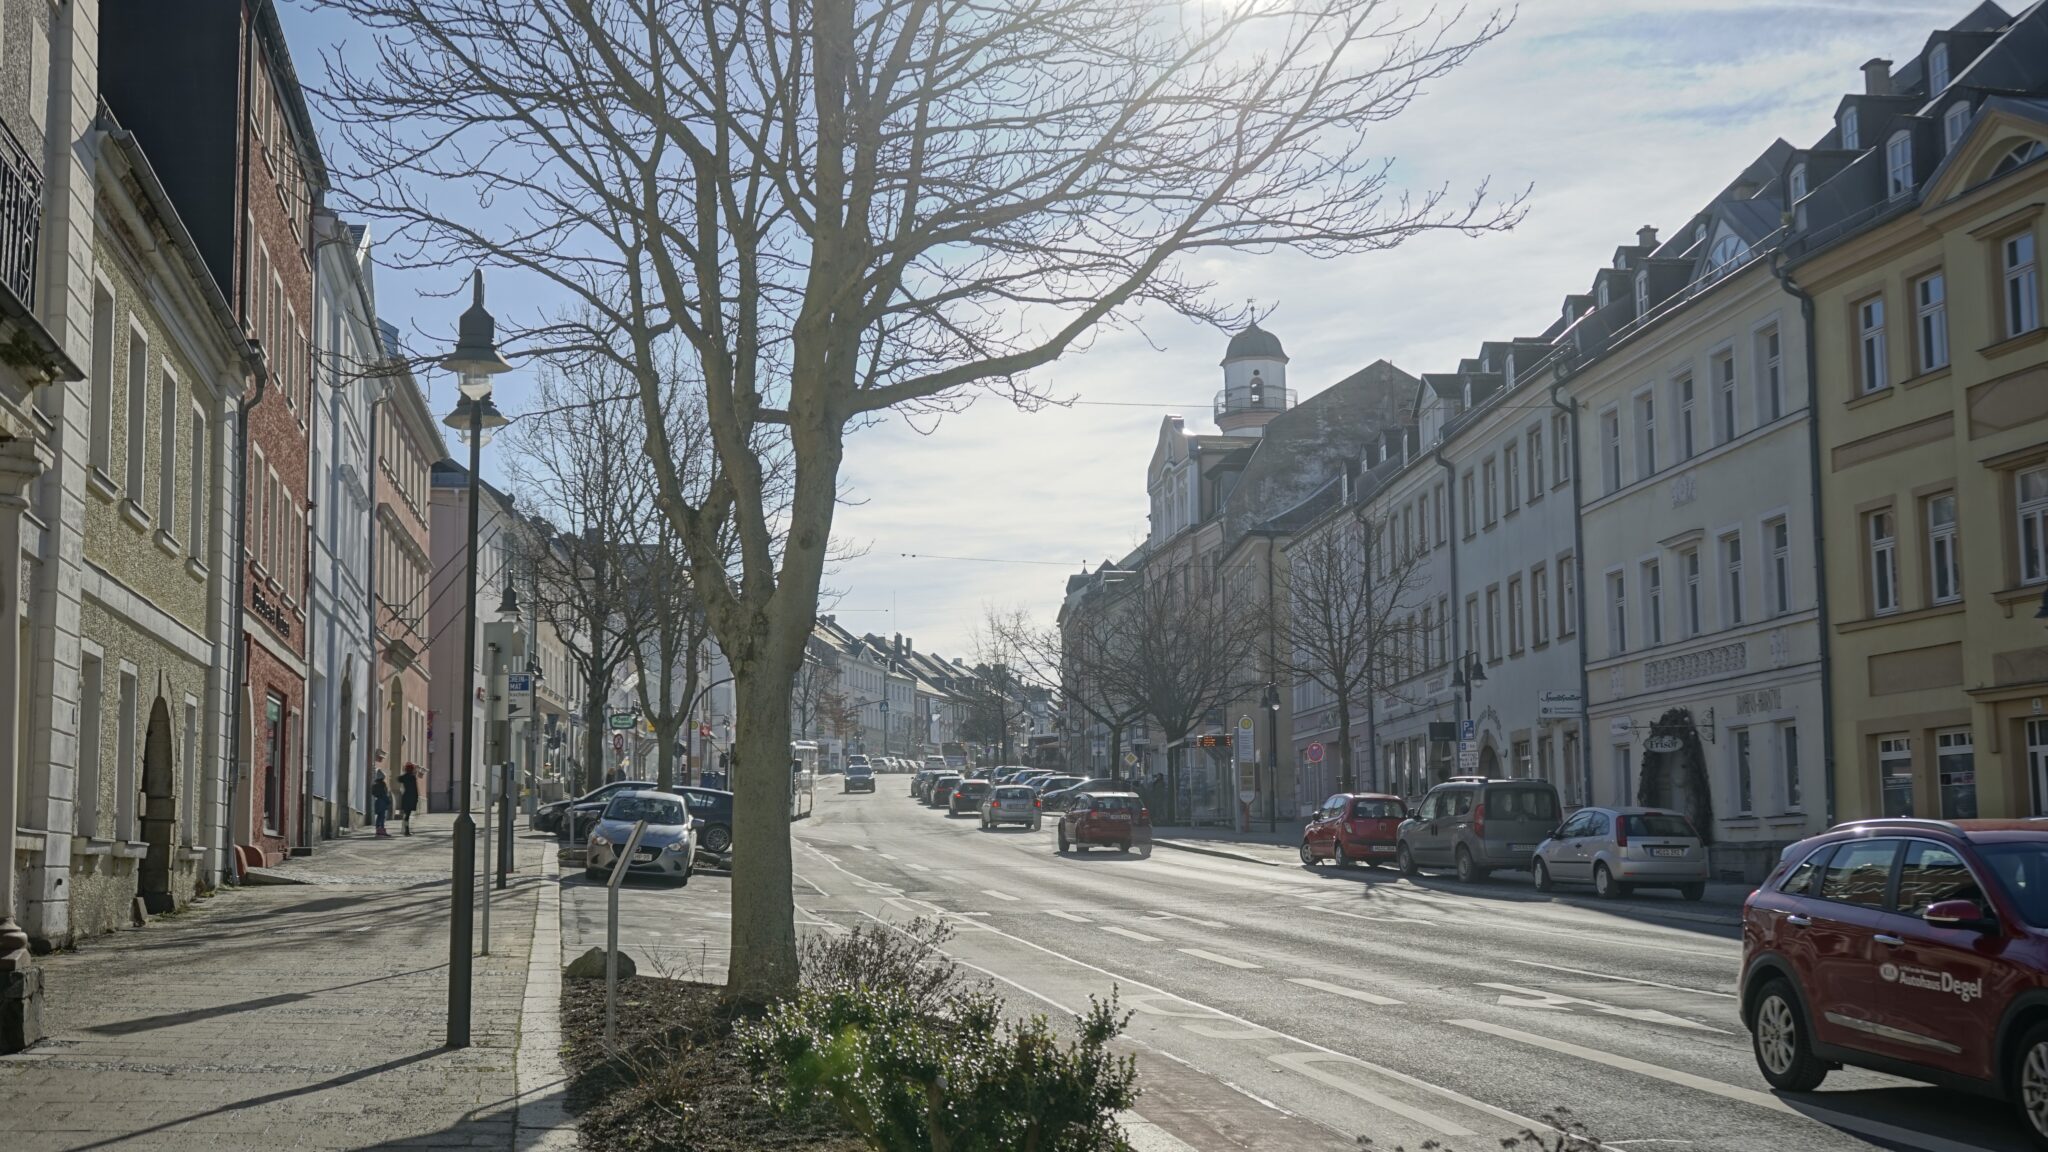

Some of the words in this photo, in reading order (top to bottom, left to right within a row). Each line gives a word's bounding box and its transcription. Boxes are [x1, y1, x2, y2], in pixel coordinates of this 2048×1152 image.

[1463, 722, 1470, 732] P
[1899, 971, 1941, 991] Autohaus
[1941, 971, 1982, 1002] Degel
